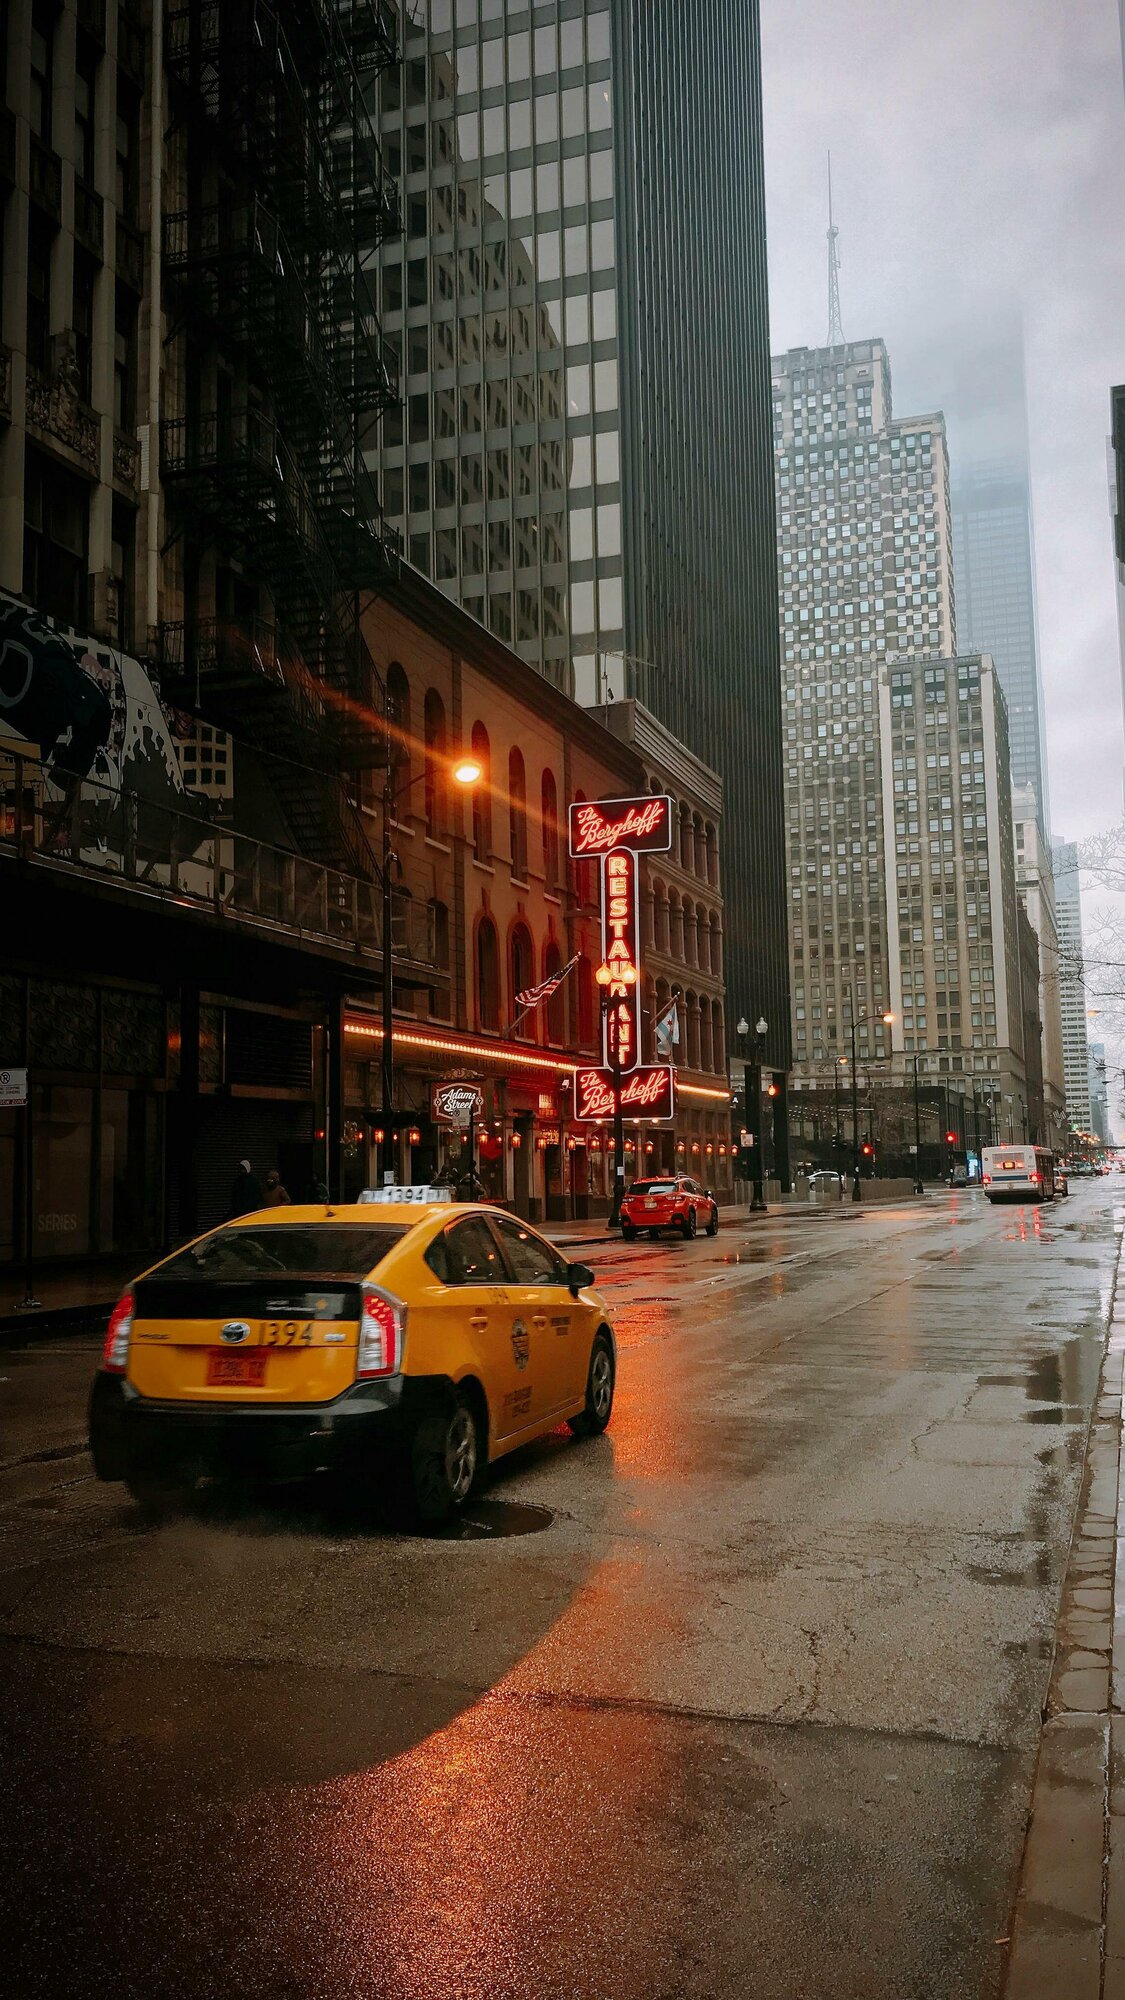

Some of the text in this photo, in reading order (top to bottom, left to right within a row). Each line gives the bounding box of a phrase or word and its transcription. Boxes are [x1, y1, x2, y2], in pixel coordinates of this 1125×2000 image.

[577, 807, 599, 824] The
[576, 802, 664, 852] Berghoff
[580, 1071, 601, 1089] The
[441, 1088, 476, 1102] Adams
[443, 1099, 474, 1113] Street
[38, 1214, 77, 1232] SERIES
[259, 1322, 313, 1346] 1394
